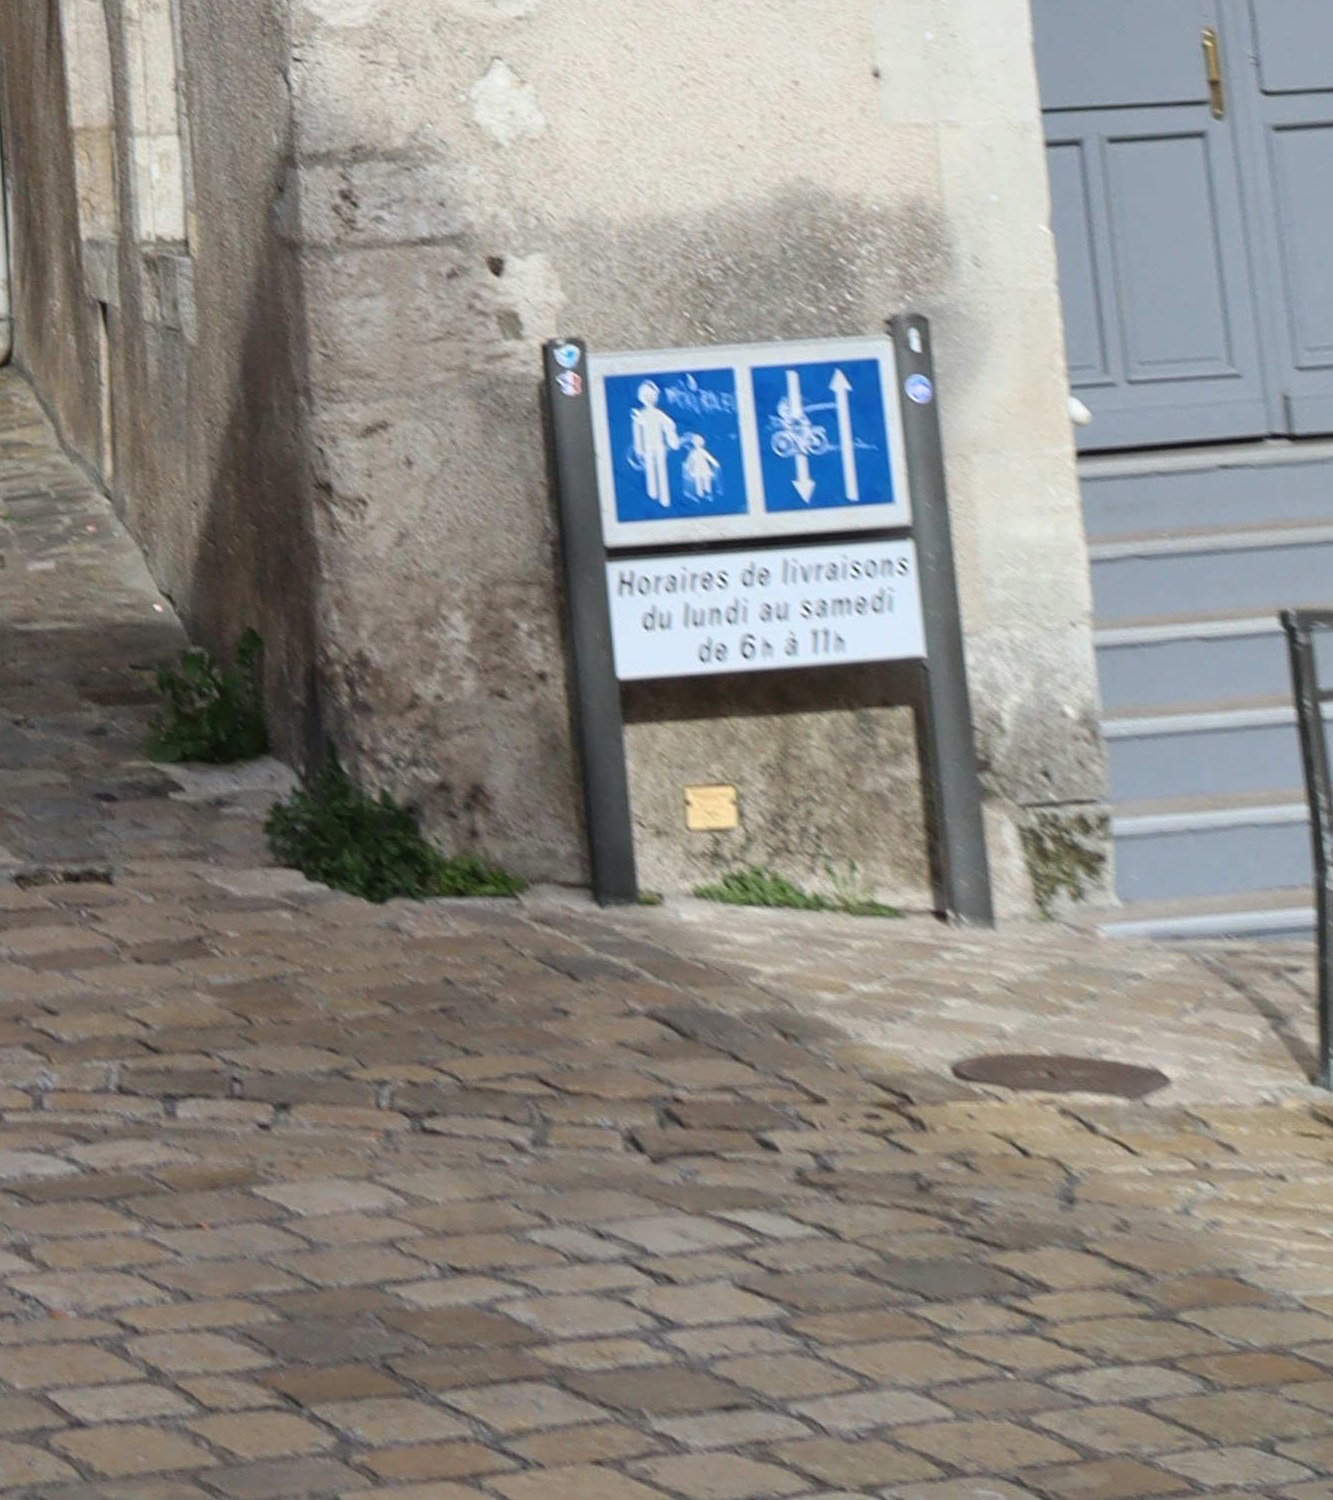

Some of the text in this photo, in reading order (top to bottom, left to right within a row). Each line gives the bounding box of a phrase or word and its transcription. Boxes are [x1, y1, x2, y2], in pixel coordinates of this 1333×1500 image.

[616, 555, 909, 597] Horaires de livraisons
[642, 586, 895, 631] du lundi au samedi
[698, 628, 846, 664] de 6h à 11h
